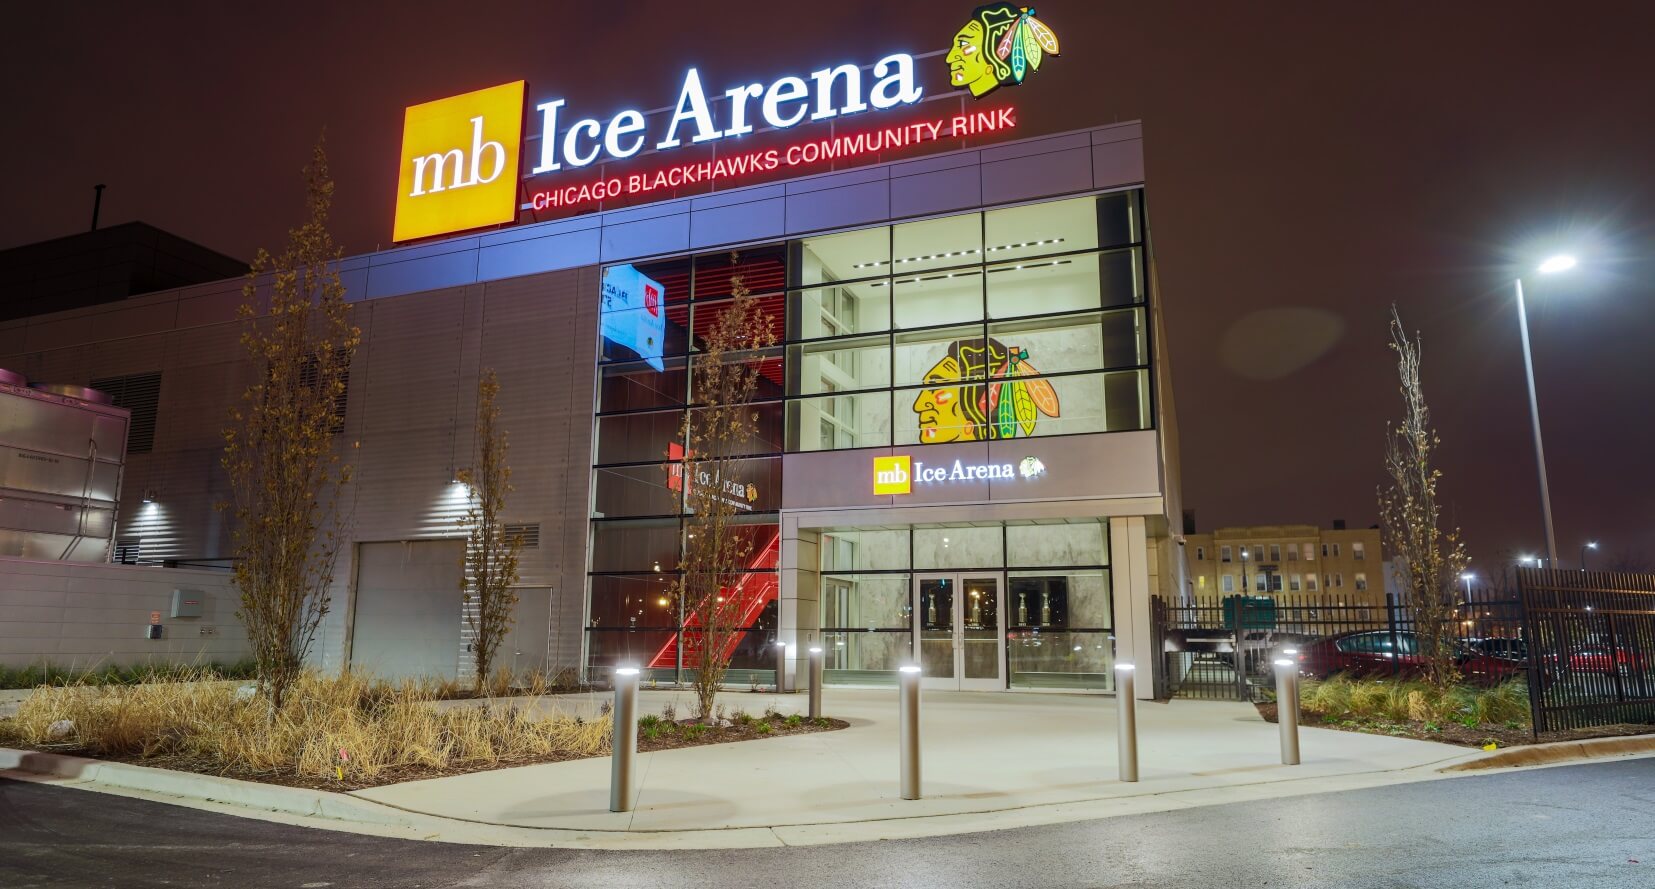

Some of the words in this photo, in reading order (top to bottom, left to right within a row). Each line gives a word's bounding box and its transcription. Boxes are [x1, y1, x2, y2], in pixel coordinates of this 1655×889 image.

[532, 98, 646, 175] Ice
[655, 53, 924, 150] Arena
[409, 115, 506, 197] mb
[533, 178, 622, 211] CHICAGO
[628, 150, 779, 194] BLACKHAWKS
[786, 119, 944, 166] COMMUNITY
[951, 107, 1016, 138] RINK
[876, 463, 908, 485] mb
[914, 462, 947, 483] Ice
[948, 459, 1015, 481] Arena
